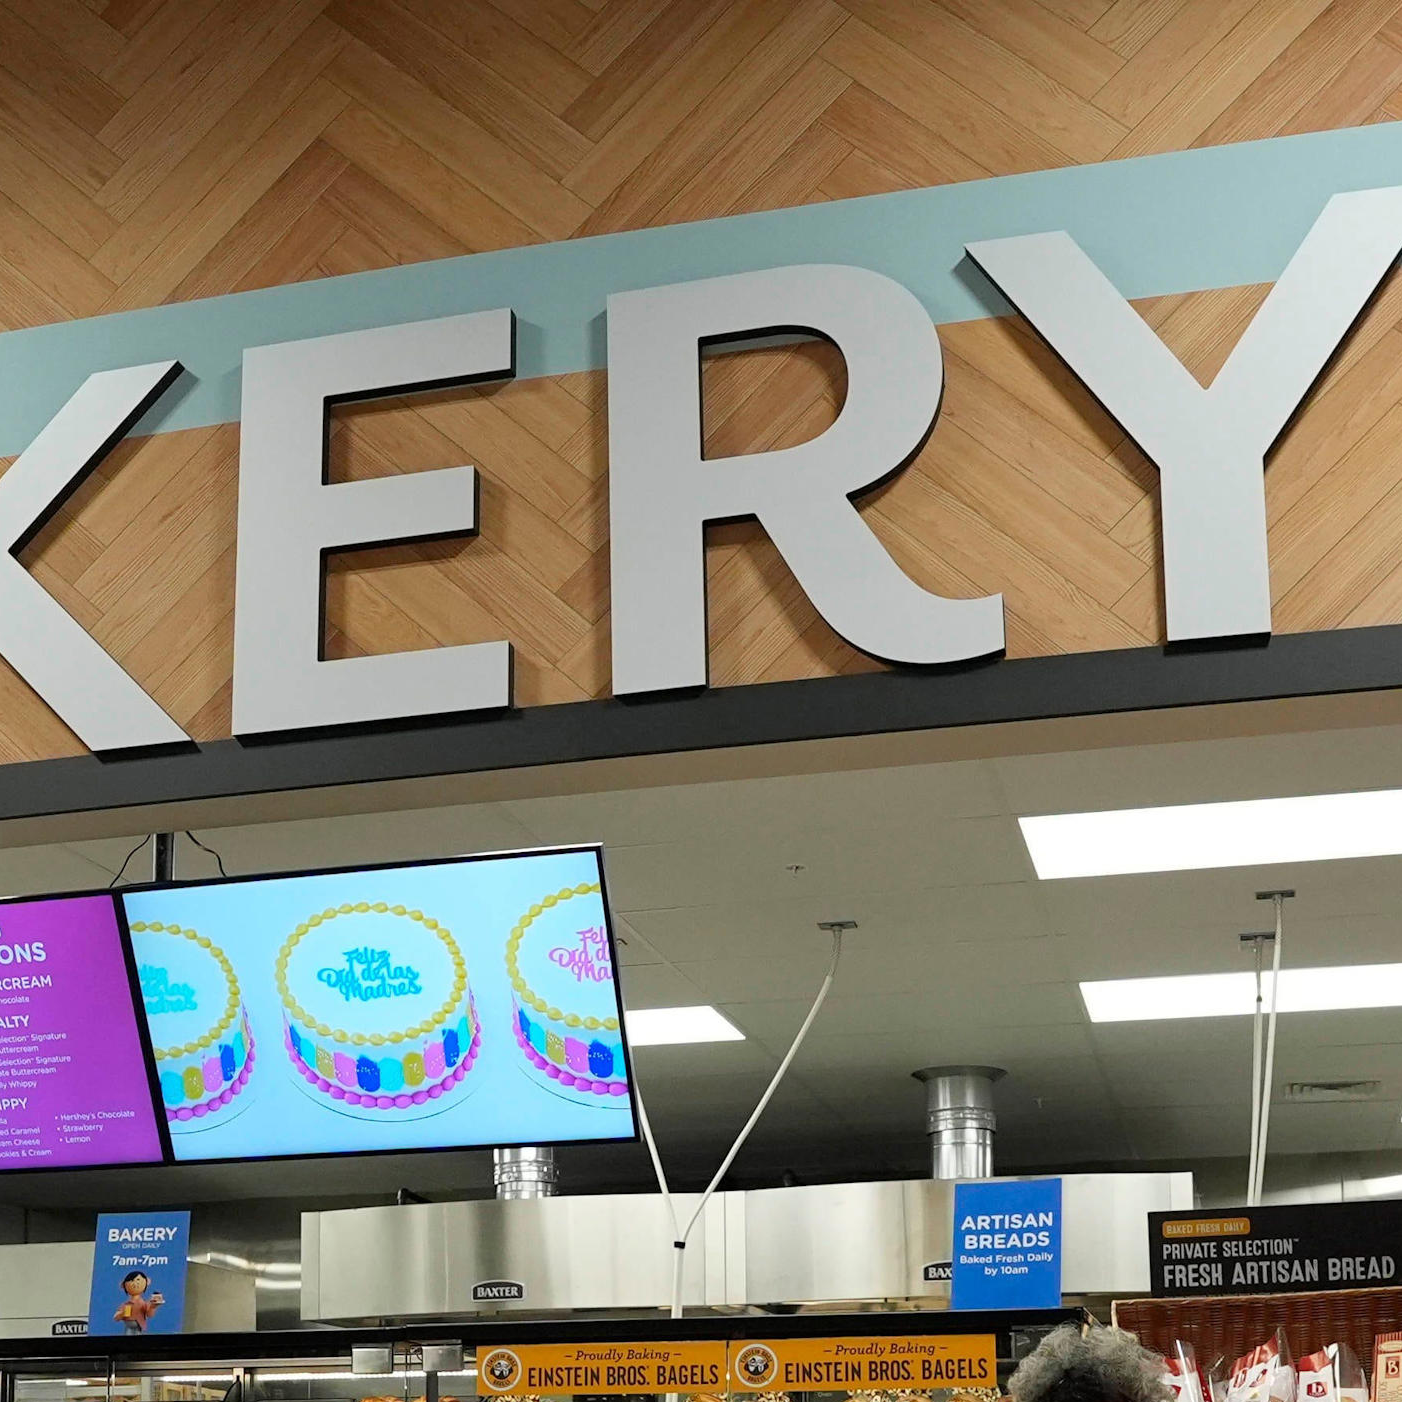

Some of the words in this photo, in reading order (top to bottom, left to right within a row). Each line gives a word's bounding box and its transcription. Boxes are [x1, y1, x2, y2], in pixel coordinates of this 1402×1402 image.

[30, 1032, 67, 1045] Signature
[35, 1054, 72, 1067] Signature
[11, 1066, 57, 1077] Buttercream
[8, 1079, 38, 1090] Whippy
[60, 1112, 96, 1123] Hershey's
[97, 1110, 135, 1120] Chocolate
[11, 1126, 41, 1136] Caramel
[62, 1123, 104, 1134] Strawberry
[14, 1138, 41, 1147] Cheese
[65, 1135, 91, 1144] Lemon
[28, 1149, 53, 1158] Cream
[960, 1211, 1054, 1231] ARTISAN
[107, 1226, 178, 1243] BAKERY
[964, 1231, 1050, 1250] BREADS
[121, 1242, 141, 1250] OPEN
[141, 1241, 162, 1250] DAILY
[1162, 1240, 1218, 1260] PRIVATE
[111, 1254, 169, 1268] 7am-7pm
[959, 1254, 993, 1265] Baked
[995, 1253, 1025, 1264] Fresh
[1027, 1251, 1054, 1264] Daily
[928, 1266, 953, 1279] BAX
[984, 1266, 998, 1277] by
[1000, 1265, 1029, 1275] 10am
[1163, 1262, 1224, 1288] FRESH
[1231, 1258, 1320, 1286] ARTISAN
[1327, 1255, 1396, 1282] BREAD
[476, 1283, 523, 1301] BAXTER
[576, 1349, 624, 1363] Proudly
[626, 1349, 671, 1362] Baking
[835, 1343, 886, 1358] Proudly
[889, 1342, 936, 1356] Baking
[527, 1365, 600, 1387] EINSTEIN
[656, 1364, 719, 1386] BAGELS
[784, 1361, 862, 1384] EINSTEIN
[921, 1357, 988, 1380] BAGELS
